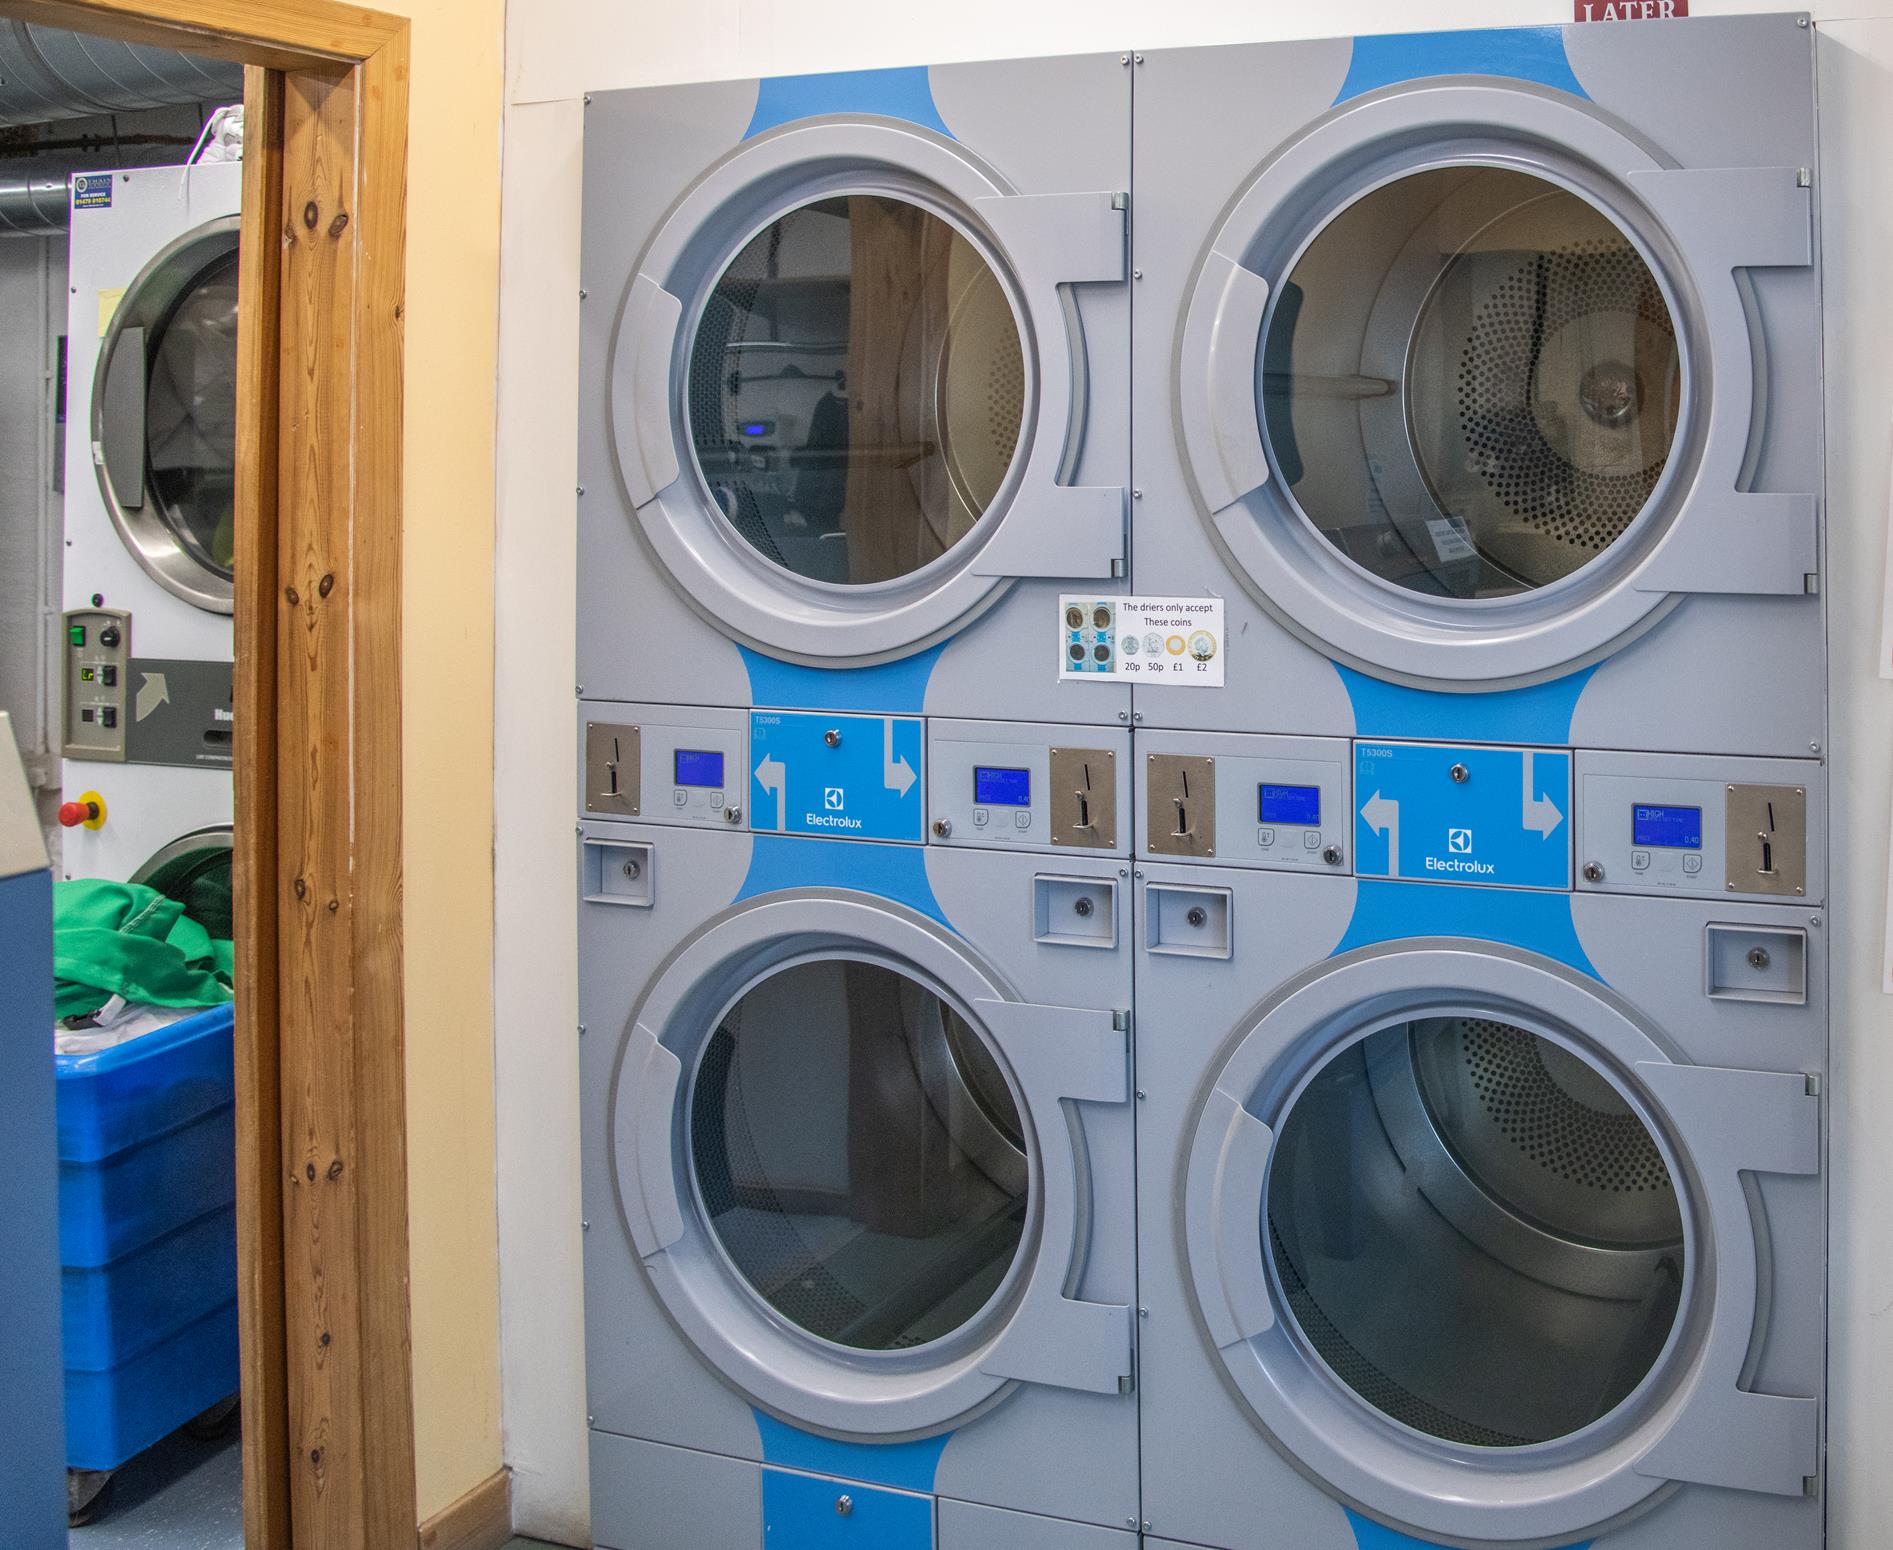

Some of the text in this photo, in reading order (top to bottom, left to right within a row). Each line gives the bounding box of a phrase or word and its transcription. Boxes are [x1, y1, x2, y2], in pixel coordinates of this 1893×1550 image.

[1583, 0, 1675, 22] LATER
[1123, 603, 1213, 613] The driers only accept
[1144, 618, 1192, 626] These coins
[1125, 662, 1207, 672] 20p 50p £1 £2
[1361, 748, 1393, 758] T5300S
[806, 813, 862, 829] Electrolux
[1425, 857, 1495, 874] Electrolux
